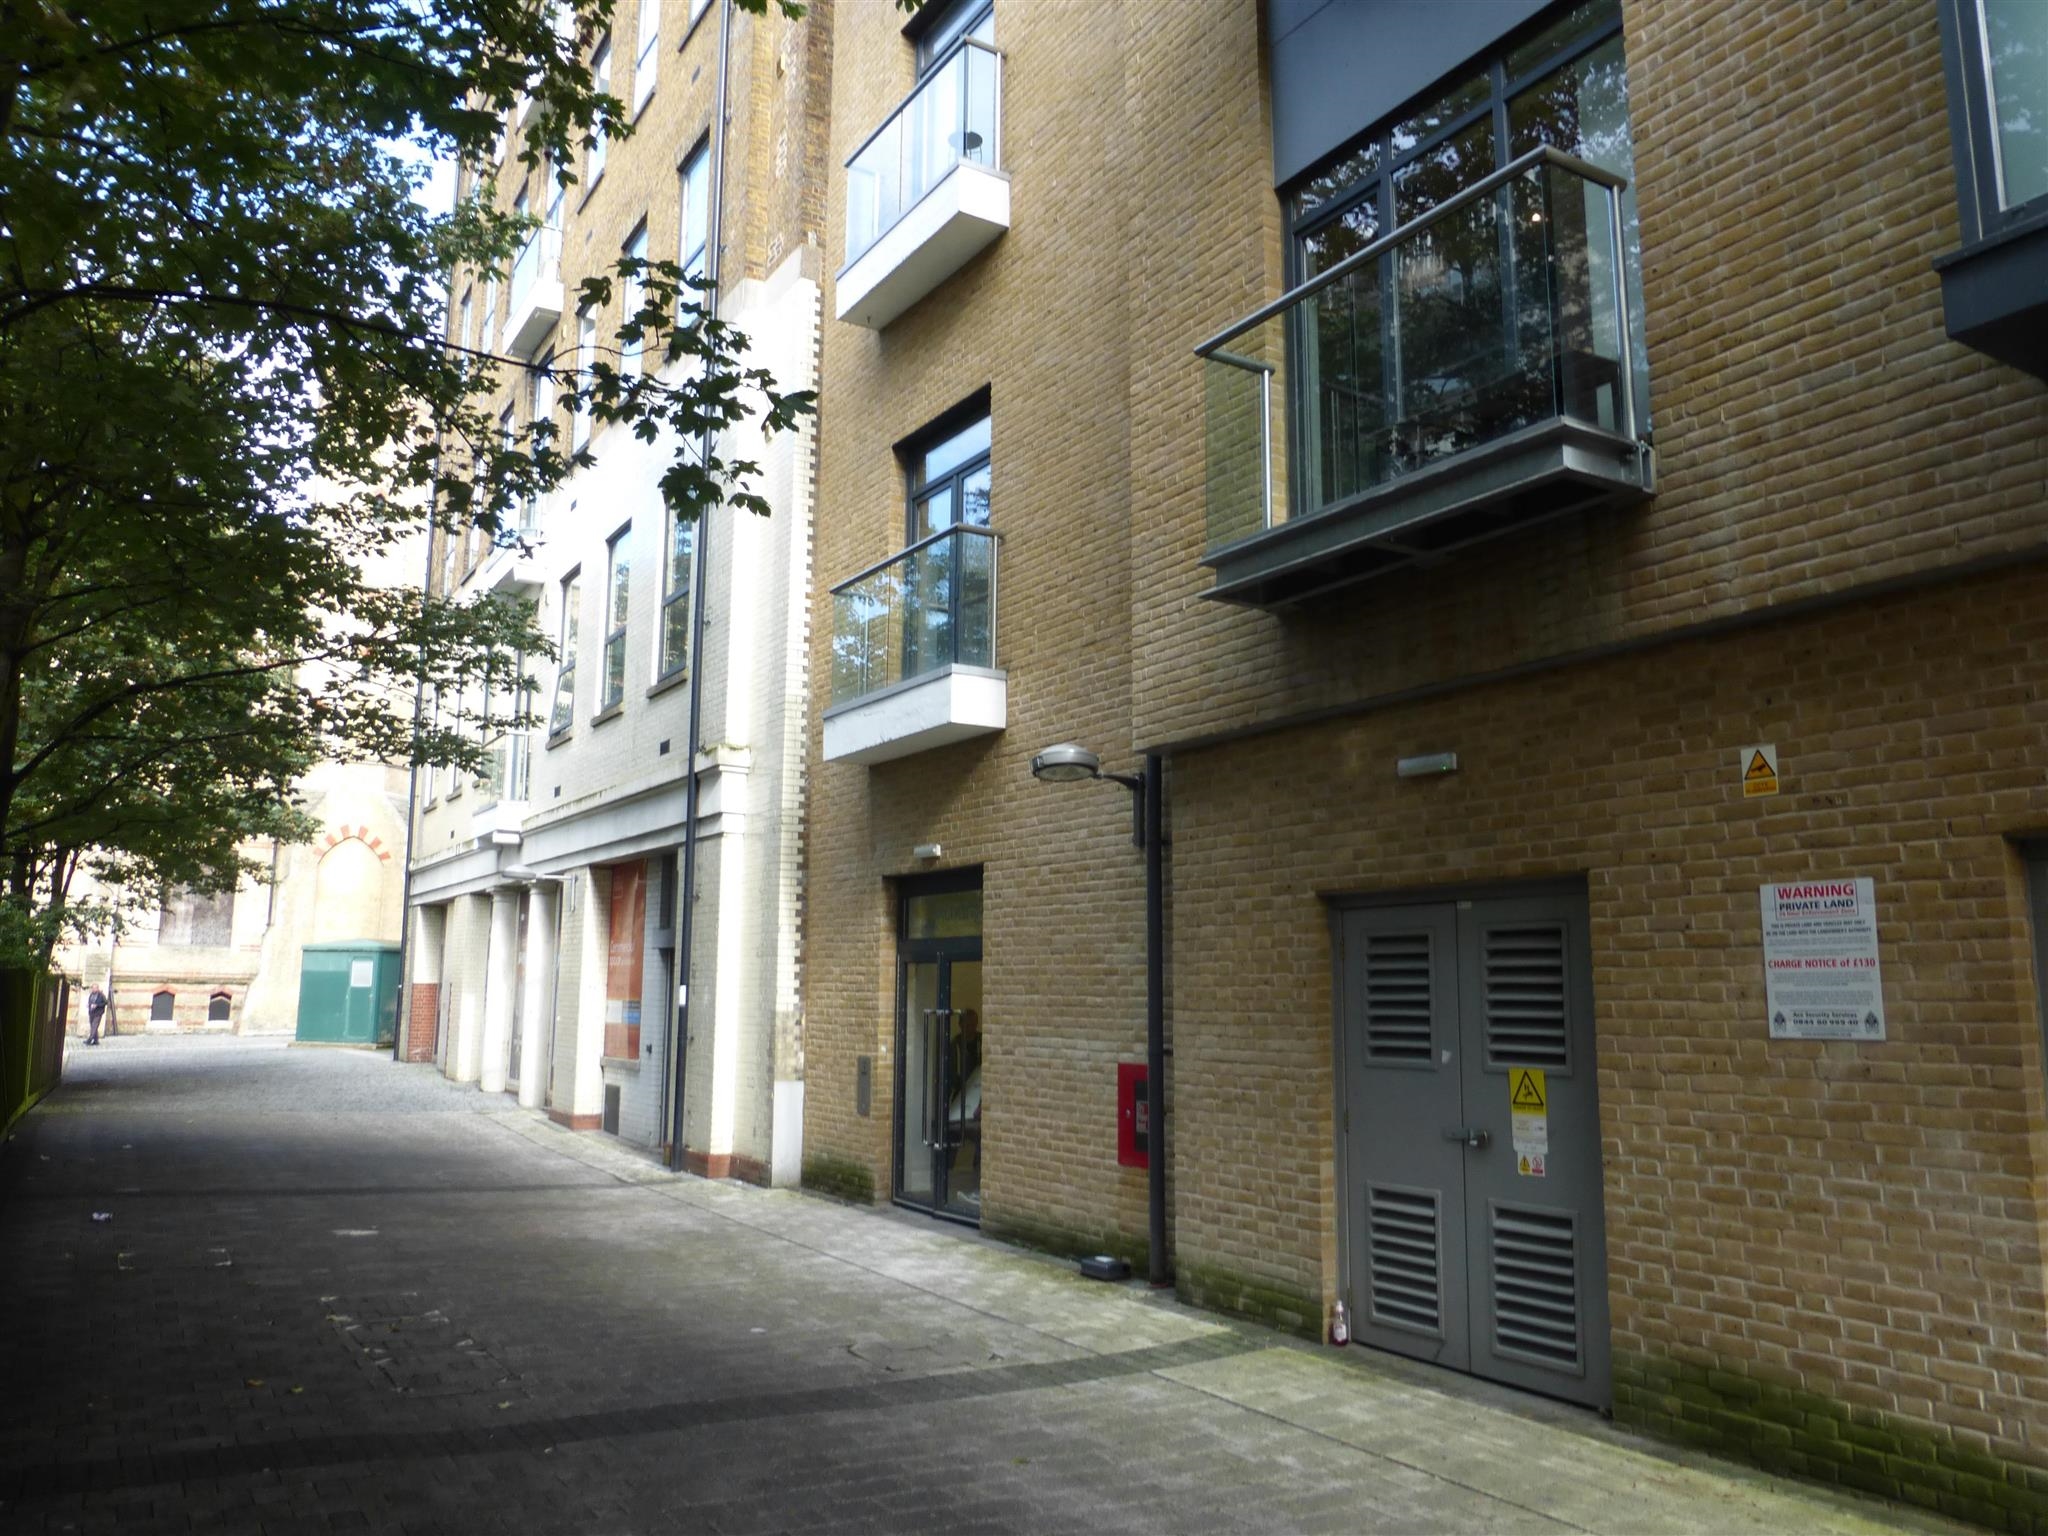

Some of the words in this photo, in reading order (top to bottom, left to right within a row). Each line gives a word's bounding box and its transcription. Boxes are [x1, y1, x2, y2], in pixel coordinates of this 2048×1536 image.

[1777, 883, 1854, 899] WARNING
[1779, 901, 1821, 911] PRIVATE
[1824, 899, 1854, 909] LAND
[1768, 959, 1802, 969] CHARGE
[1805, 958, 1836, 968] NOTICE
[1840, 957, 1850, 967] of
[1853, 957, 1876, 967] £130
